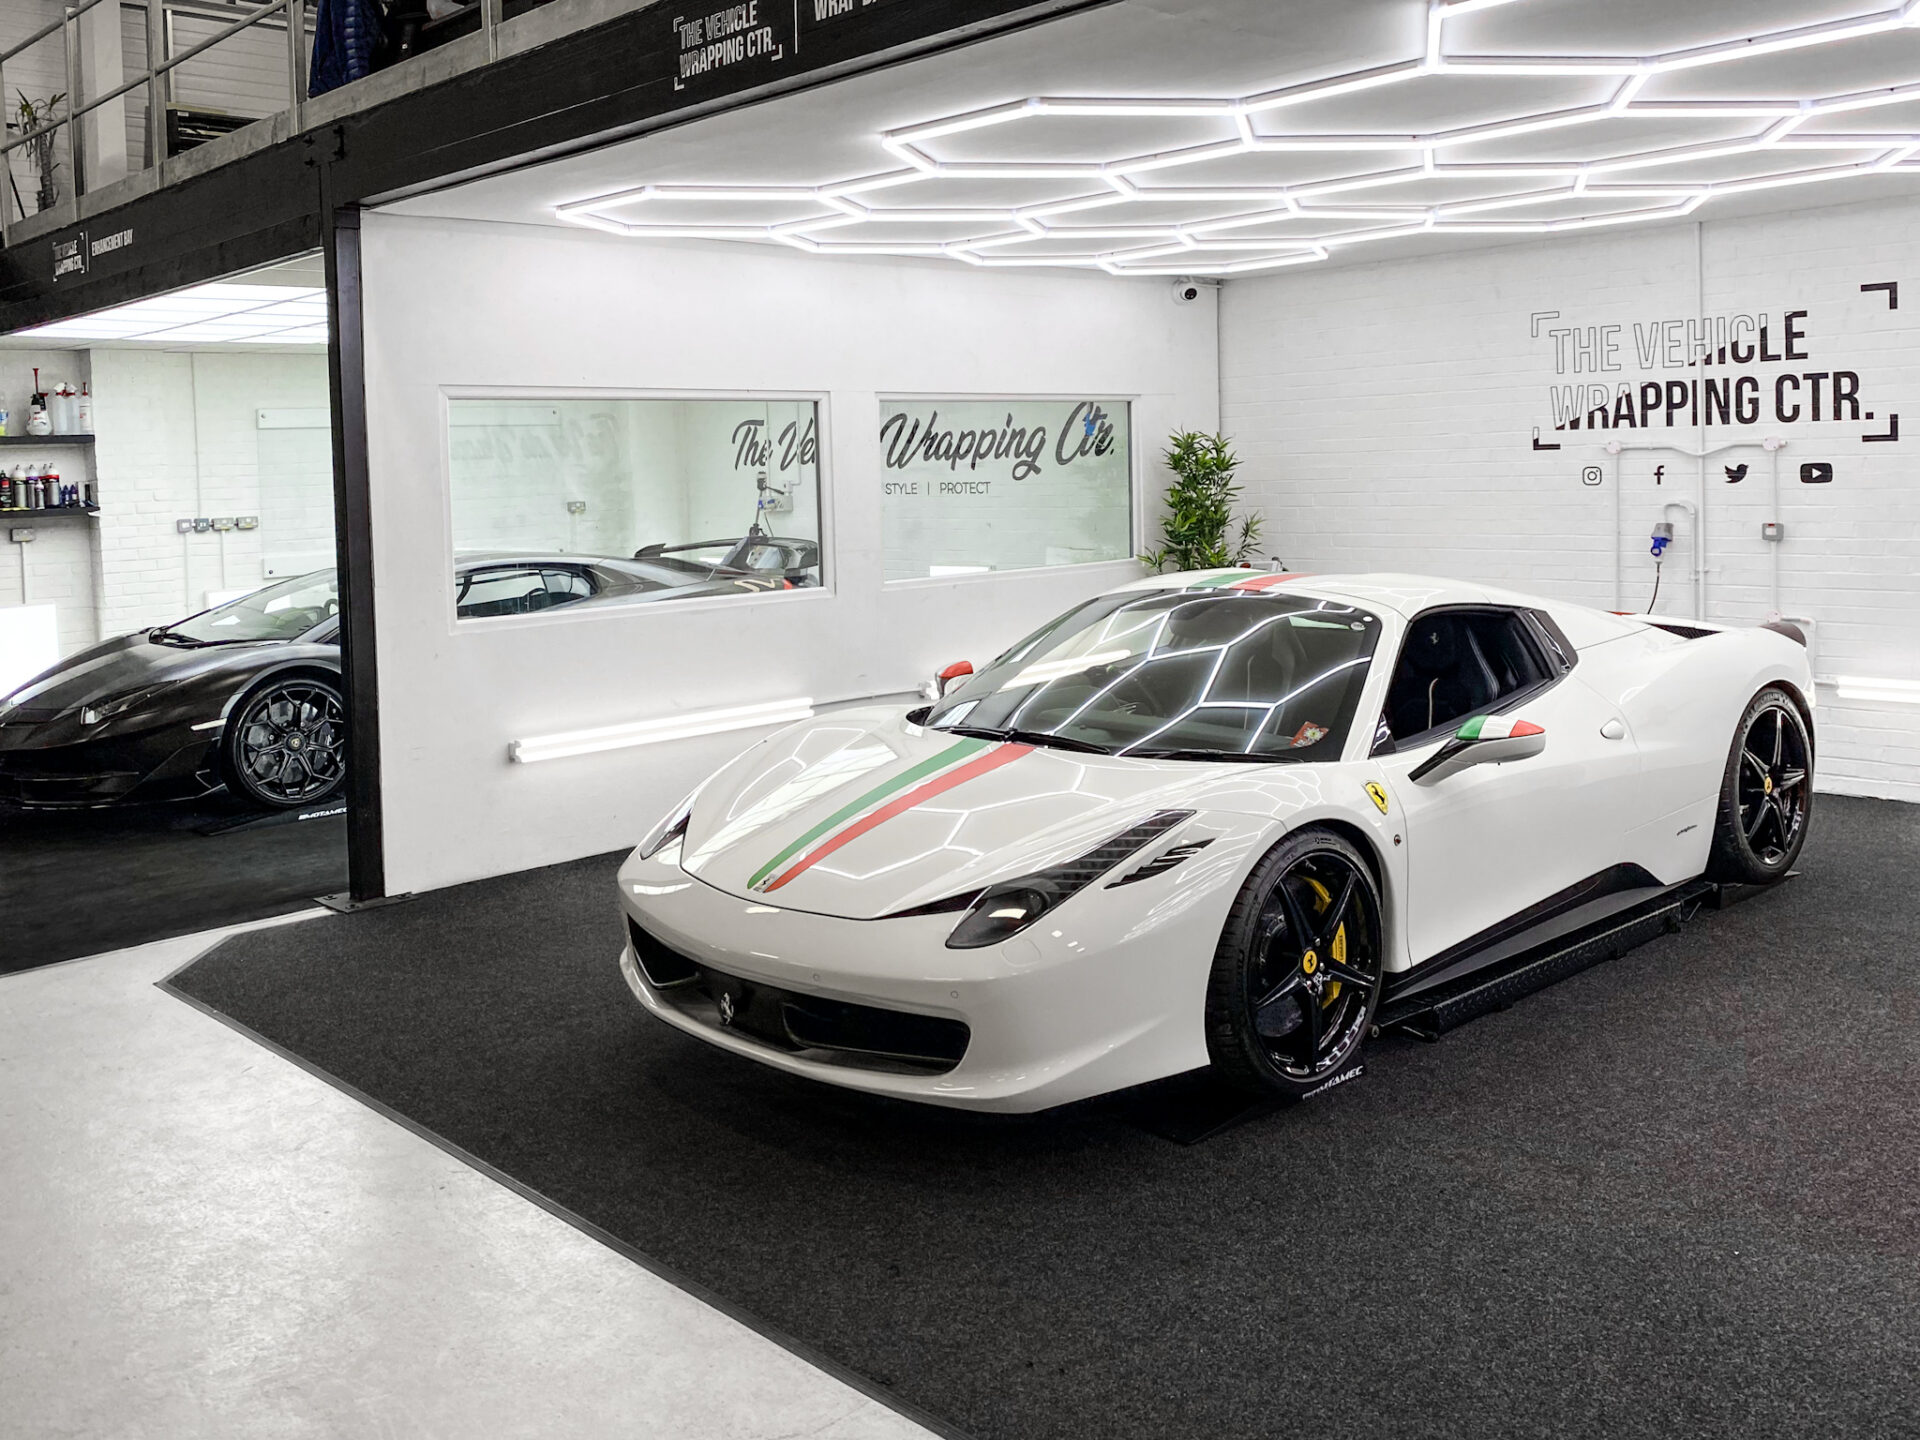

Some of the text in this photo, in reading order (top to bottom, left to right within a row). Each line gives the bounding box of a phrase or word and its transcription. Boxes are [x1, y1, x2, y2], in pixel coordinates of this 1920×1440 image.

[680, 0, 758, 49] THE VEHICLE
[680, 26, 776, 79] WRAPPING CTR.
[1549, 310, 1809, 375] THE VEHICLE
[1550, 371, 1875, 431] WRAPPING CTR.
[732, 417, 815, 471] The Ve
[880, 401, 1115, 481] Wrapping Ctr.
[885, 481, 991, 495] STYLE PROTECT
